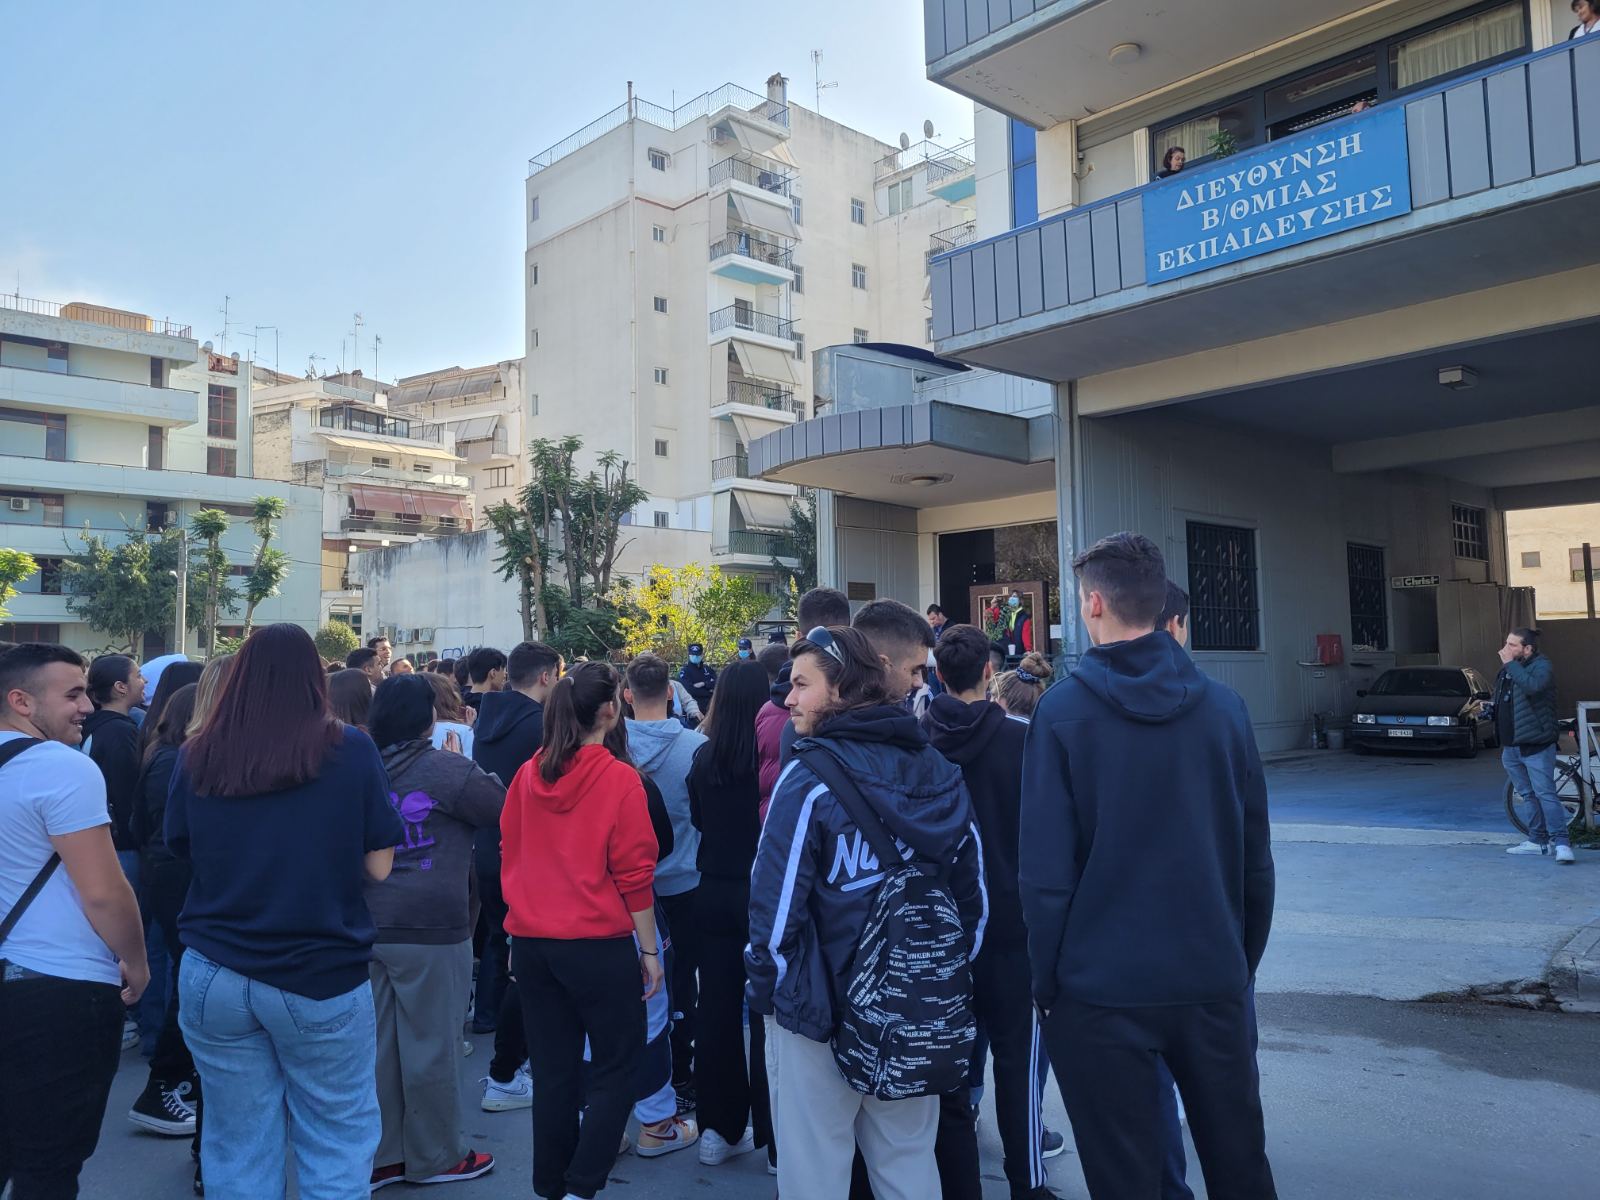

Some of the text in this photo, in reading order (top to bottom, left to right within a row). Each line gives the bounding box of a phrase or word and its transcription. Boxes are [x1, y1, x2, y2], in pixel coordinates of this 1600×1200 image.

[1177, 132, 1363, 211] ΔΙΕΥΘΥΝΣΗ
[1201, 170, 1337, 231] Β/ΘΜΙΑΣ
[1158, 184, 1393, 272] ΕΚΠΑΙΔΕΥΣΗΣ
